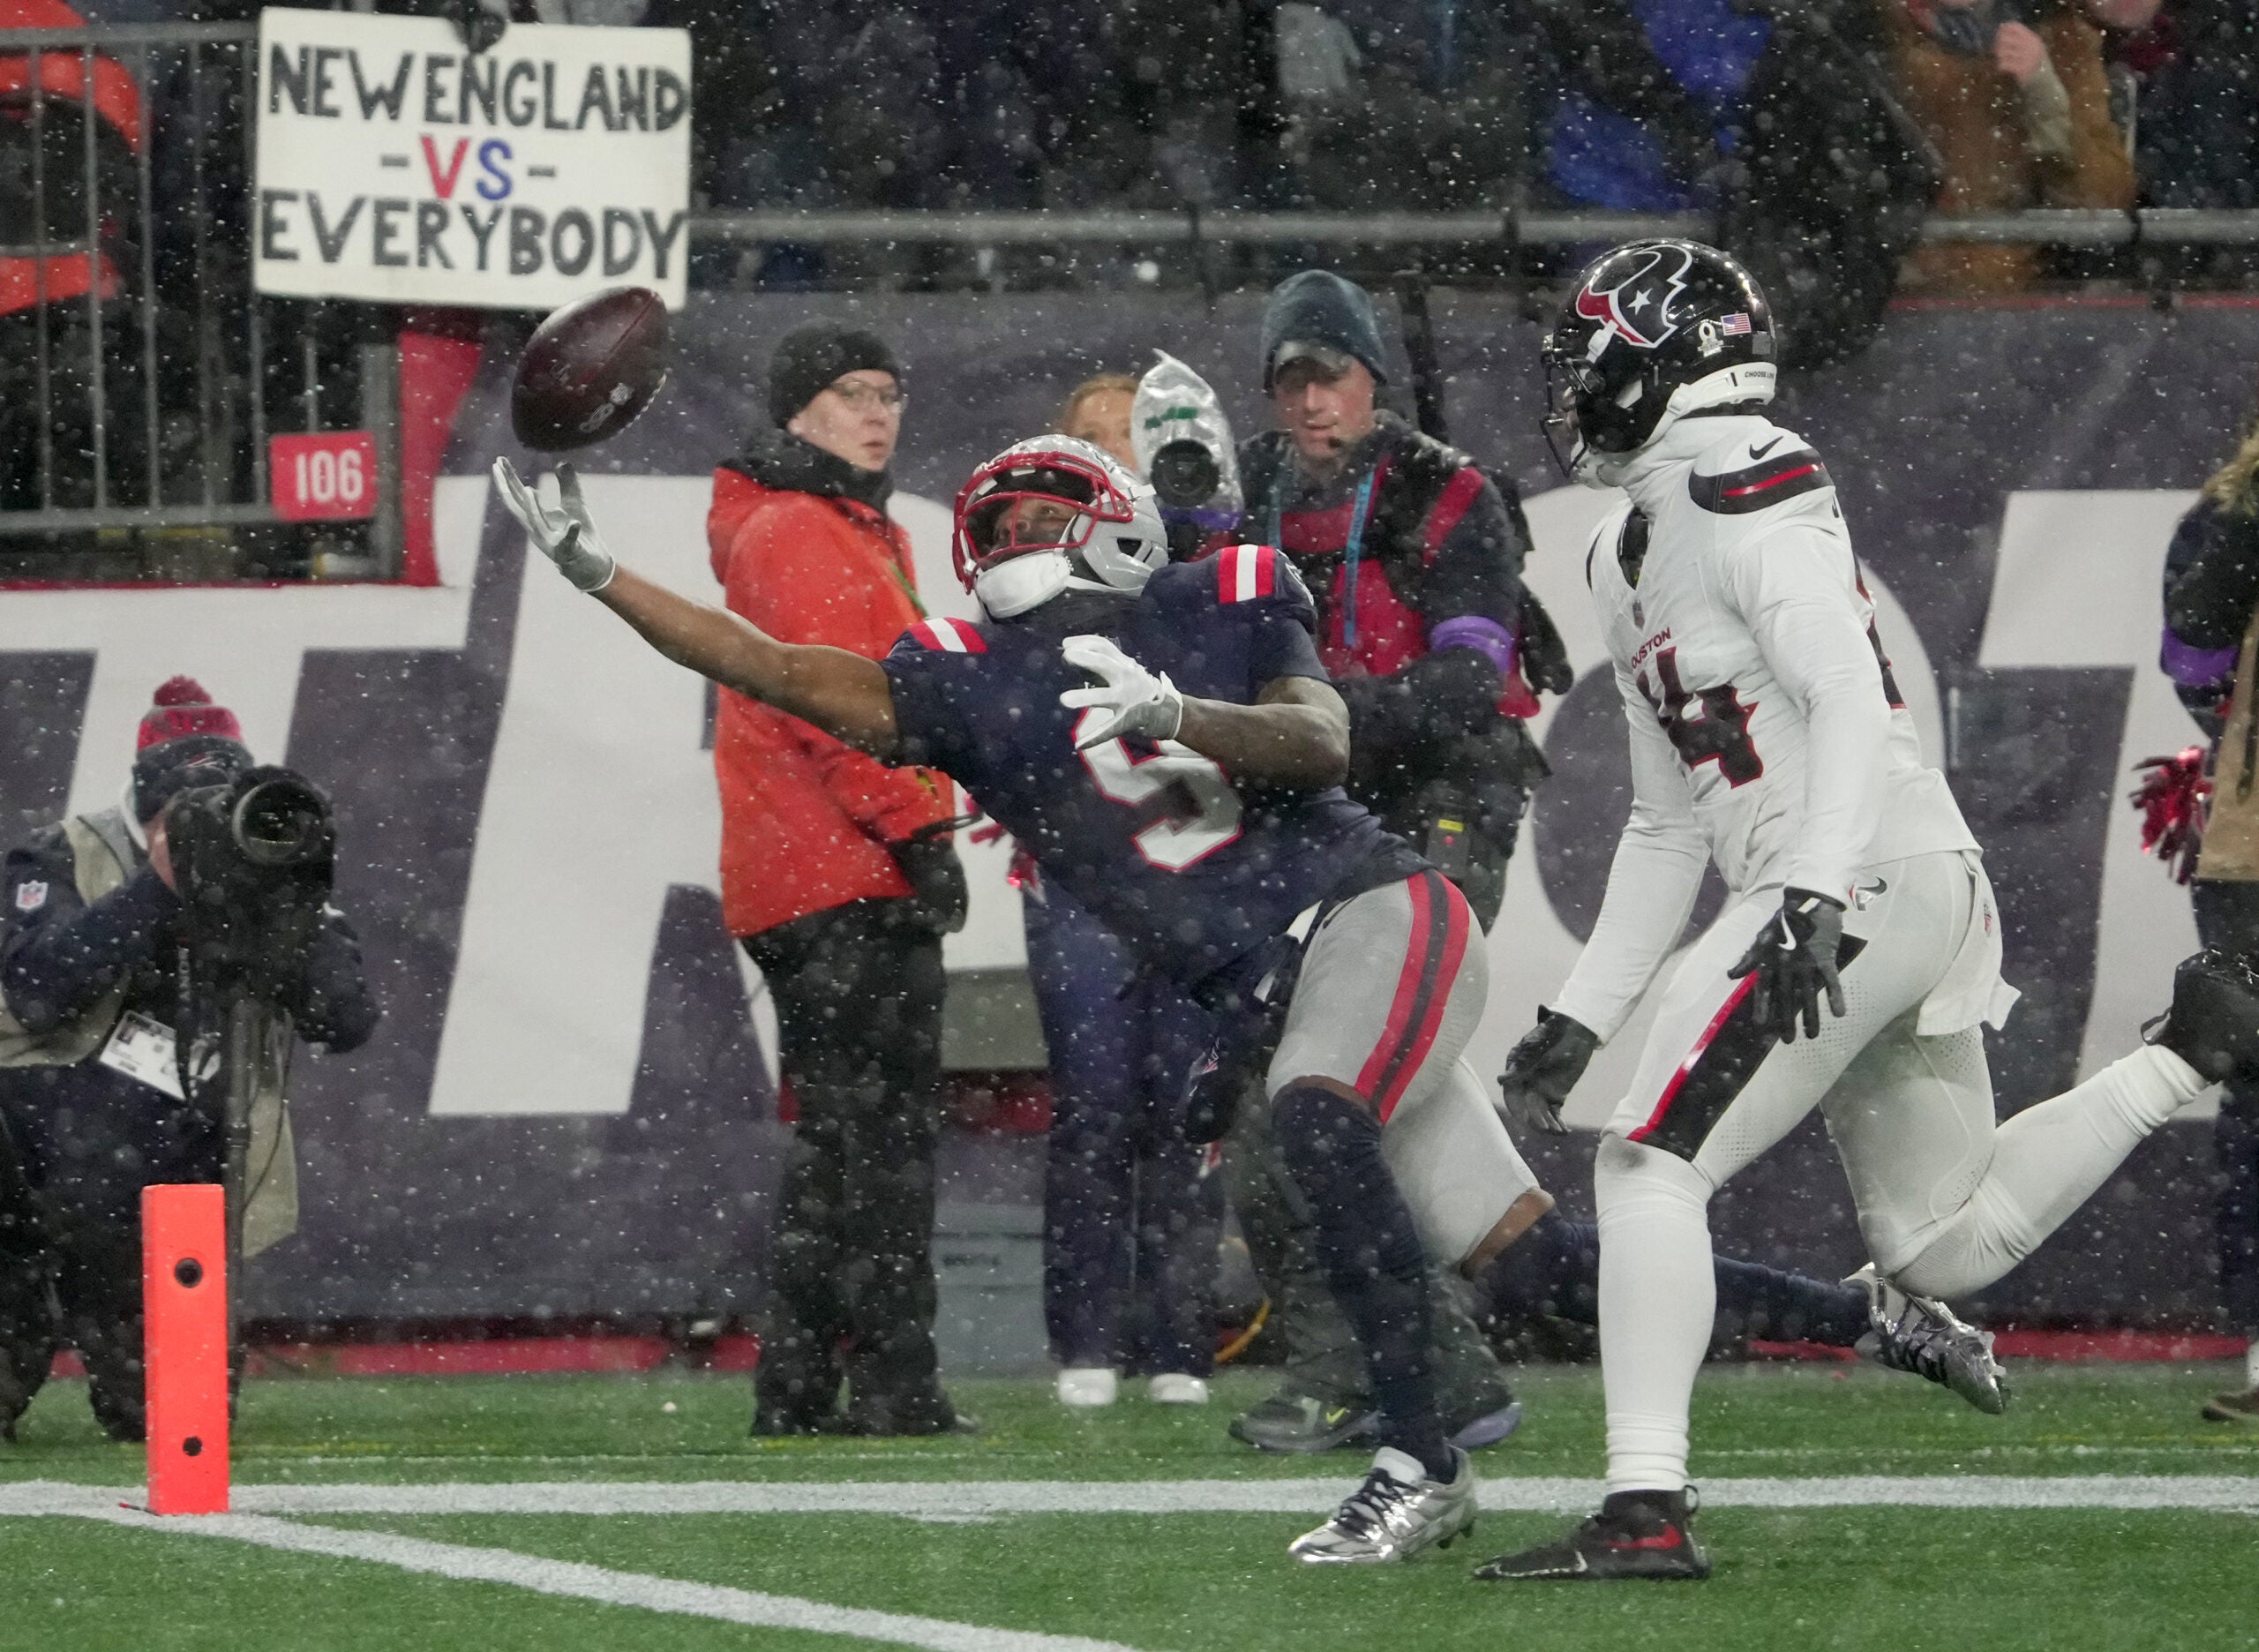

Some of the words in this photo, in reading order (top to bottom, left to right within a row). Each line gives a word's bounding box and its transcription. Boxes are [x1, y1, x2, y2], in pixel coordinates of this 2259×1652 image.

[269, 42, 415, 121] NEW
[423, 53, 691, 132] ENGLAND
[261, 188, 688, 280] EVERYBODY
[296, 448, 364, 503] 106
[1632, 627, 1671, 669] OUSTON
